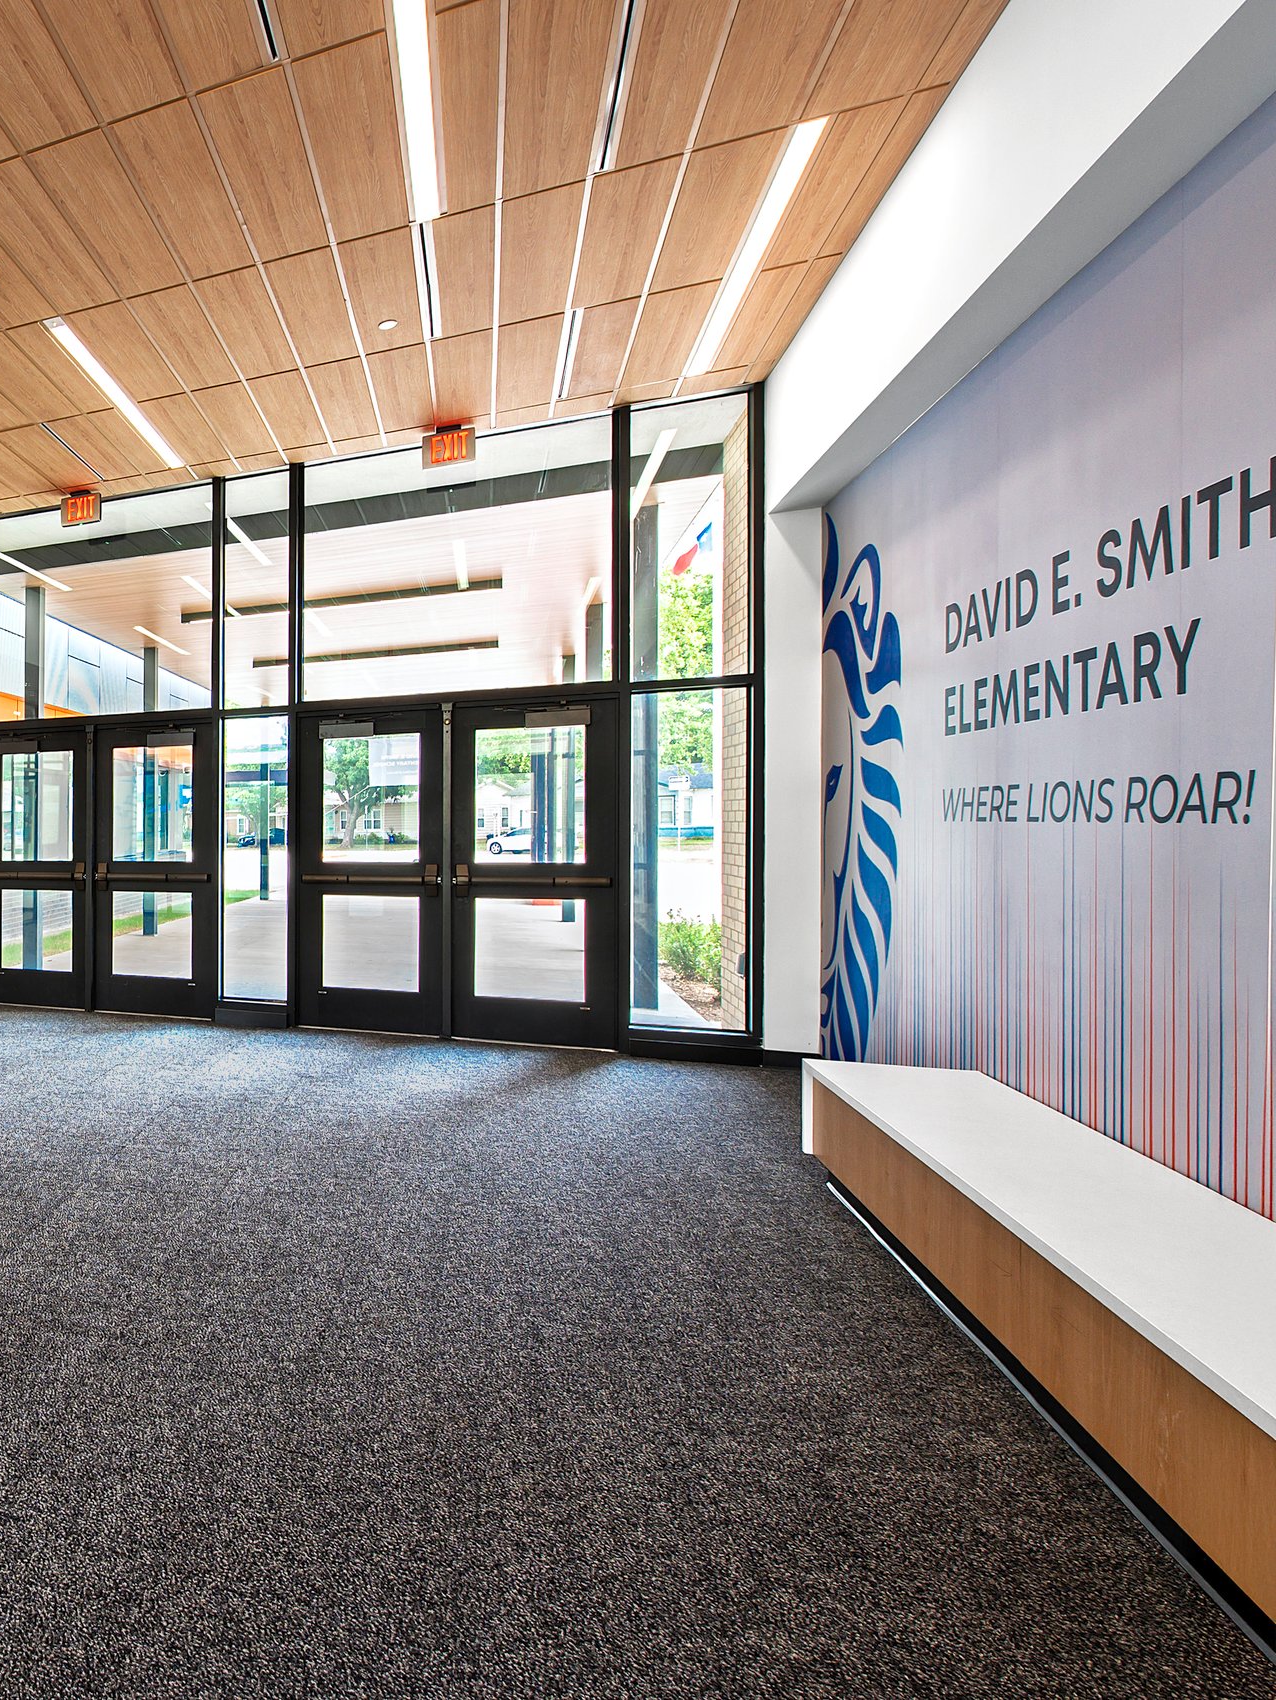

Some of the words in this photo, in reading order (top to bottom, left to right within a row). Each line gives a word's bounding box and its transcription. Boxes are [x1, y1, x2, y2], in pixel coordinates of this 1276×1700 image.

[431, 431, 469, 464] EXIT
[67, 495, 96, 522] EXIT
[944, 568, 1039, 654] DAVID
[1051, 550, 1083, 616] E.
[1096, 455, 1276, 598] SMITH
[944, 617, 1202, 737] ELEMENTARY
[942, 783, 1021, 822] WHERE
[1026, 777, 1115, 823] LIONS
[1124, 769, 1256, 825] ROAR!
